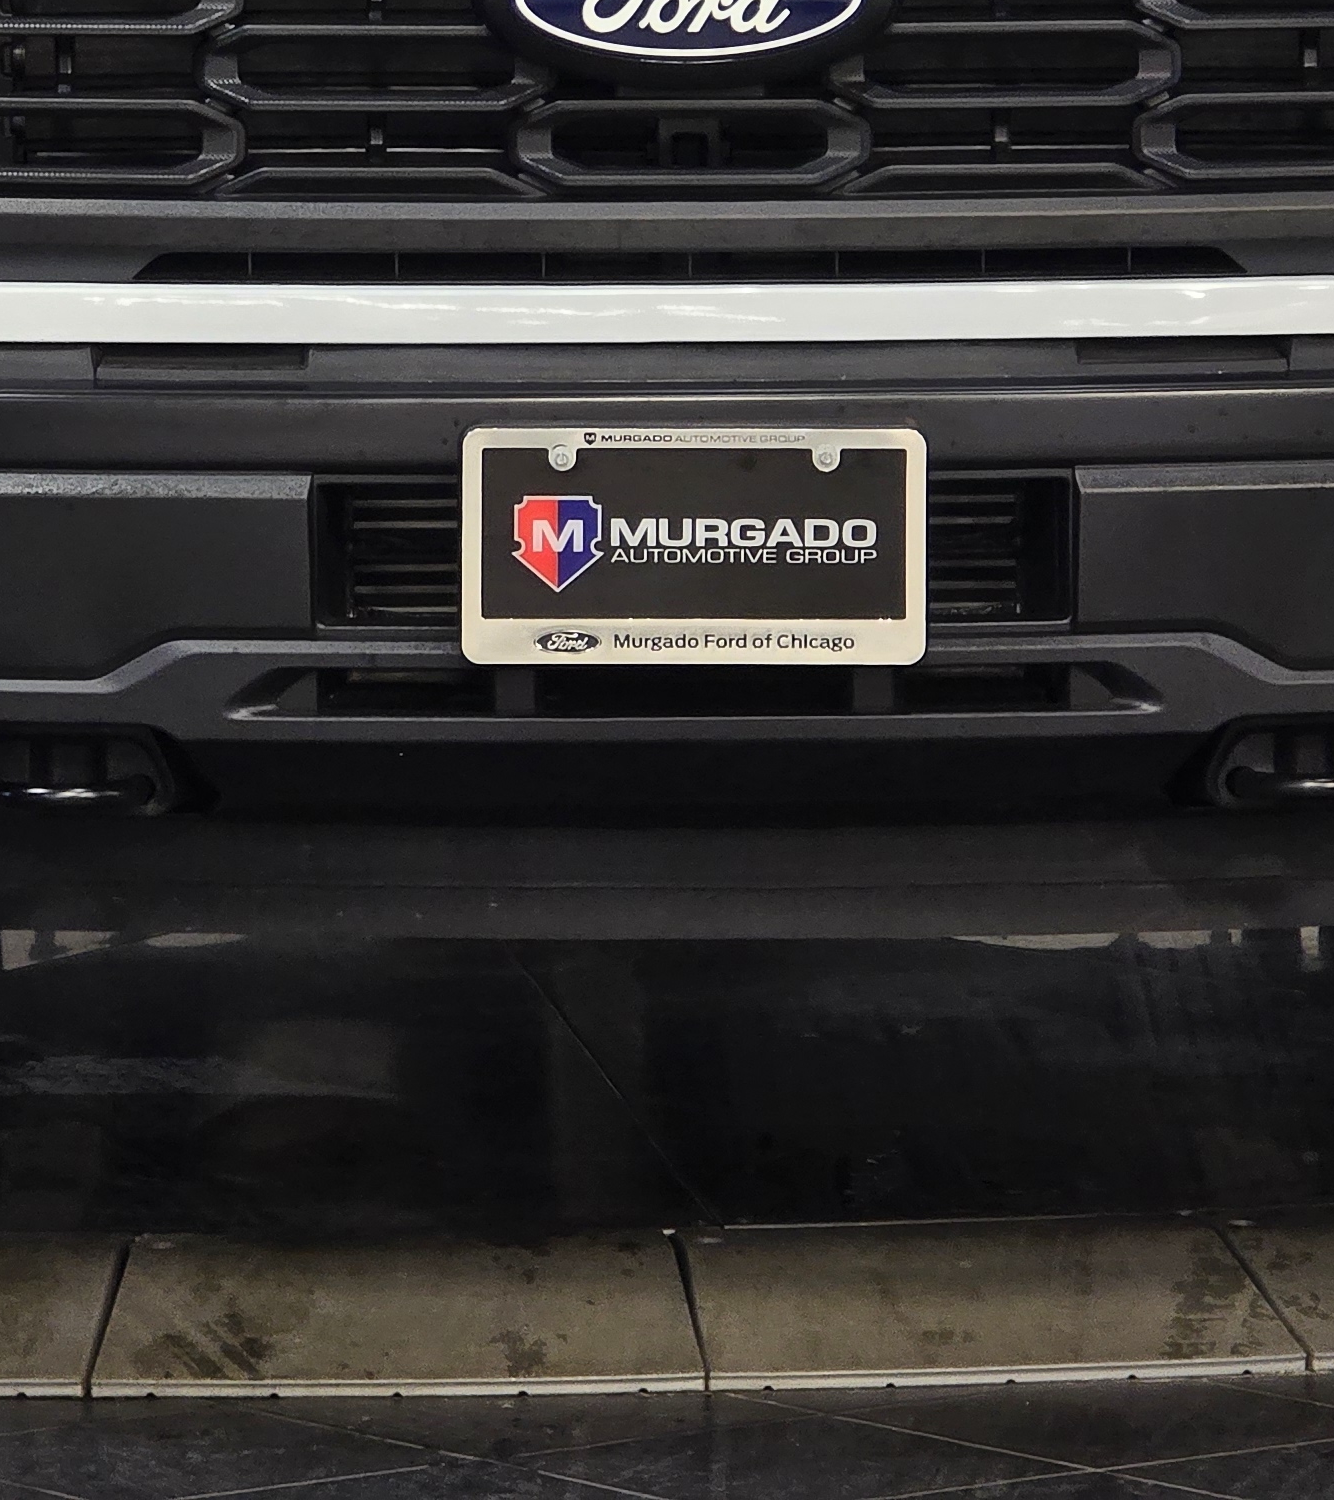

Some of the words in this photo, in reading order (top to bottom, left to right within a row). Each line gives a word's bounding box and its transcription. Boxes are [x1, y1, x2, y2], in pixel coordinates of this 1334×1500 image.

[601, 434, 673, 443] MURGADO
[674, 434, 757, 443] AUTOMOTIVE
[759, 434, 806, 443] GROUP
[533, 519, 583, 552] M
[611, 518, 877, 547] MURGADO
[611, 549, 777, 564] AUTOMOTIVE
[786, 548, 878, 564] GROUP
[547, 633, 588, 650] Ford
[614, 633, 698, 652] Murgado
[704, 633, 747, 649] Ford
[752, 633, 772, 649] of
[777, 633, 855, 652] Chicago
